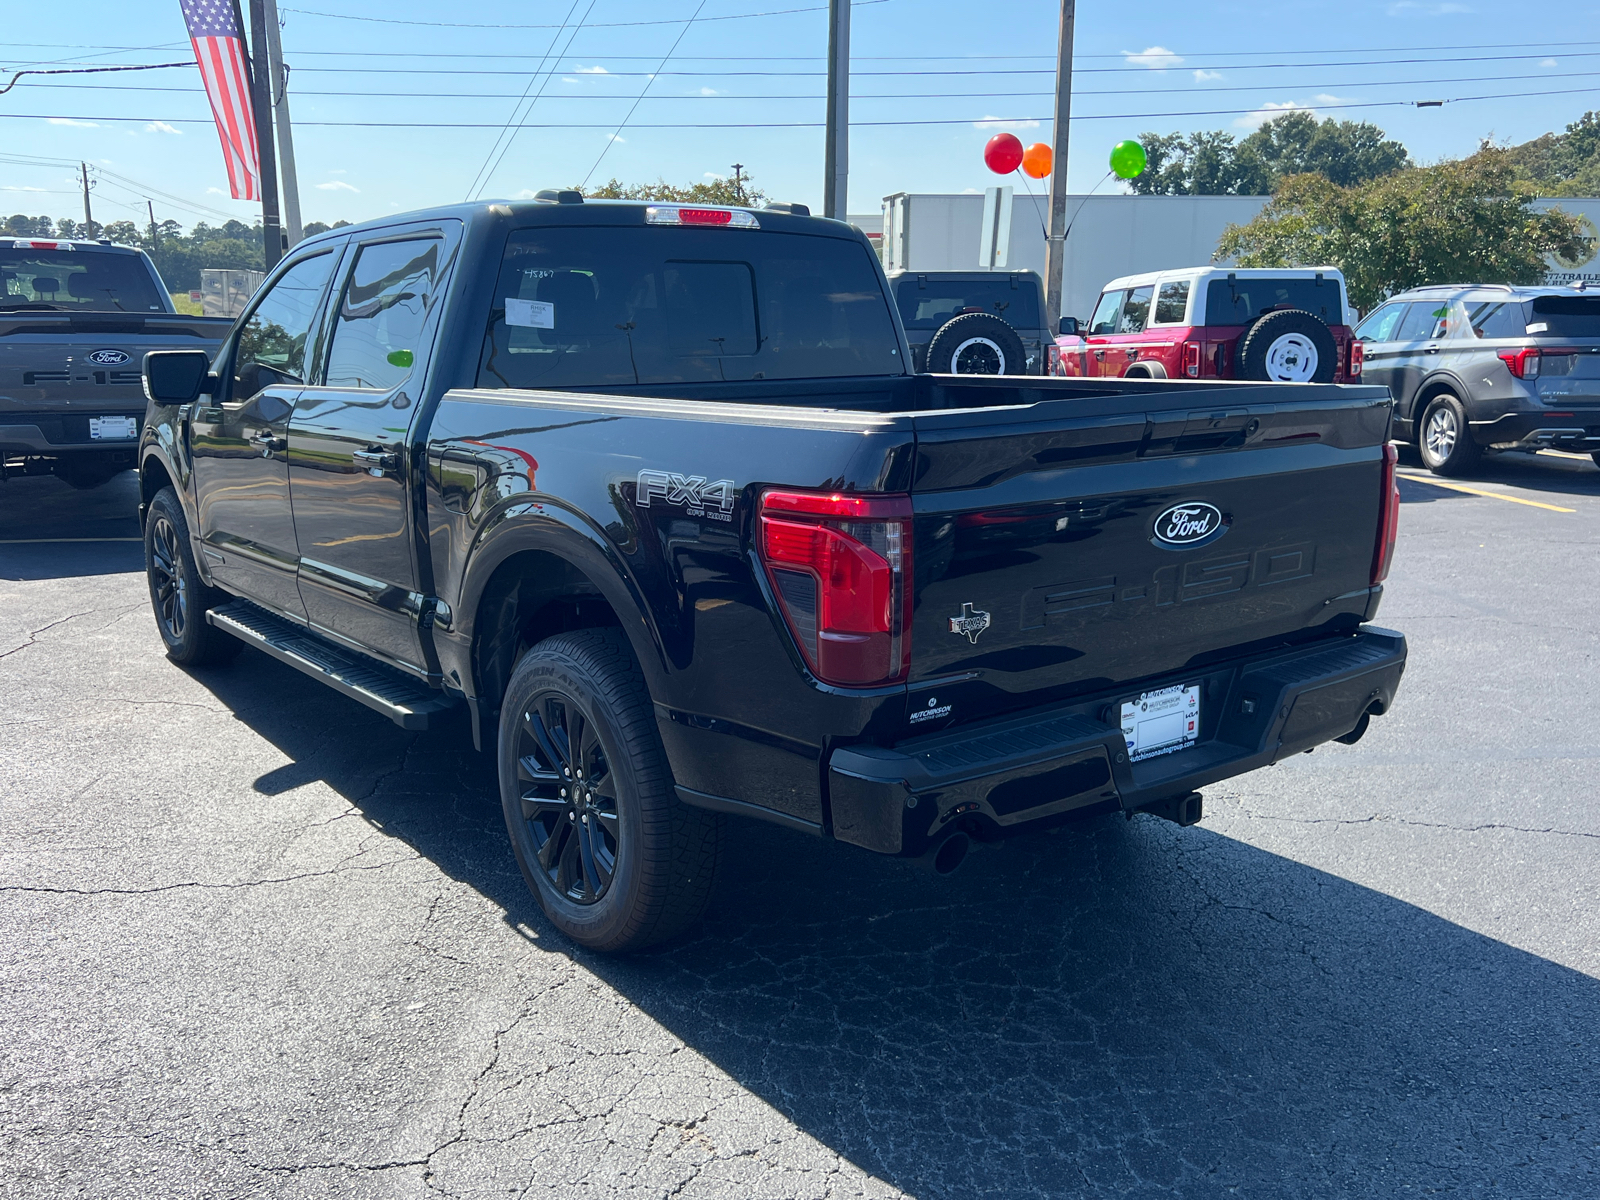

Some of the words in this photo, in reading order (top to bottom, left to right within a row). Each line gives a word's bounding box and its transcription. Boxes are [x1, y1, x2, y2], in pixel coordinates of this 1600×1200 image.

[97, 351, 123, 363] Ford
[23, 371, 143, 386] F-15
[635, 468, 734, 515] FX4
[686, 508, 705, 517] OFF
[707, 511, 733, 523] ROAD
[1166, 508, 1212, 538] Ford
[1018, 540, 1319, 632] F-150
[956, 616, 988, 630] TEXAS
[1147, 684, 1185, 699] HUTCHINSON
[1149, 696, 1181, 709] HUTCHINSON
[910, 705, 952, 720] HUTCHINSON
